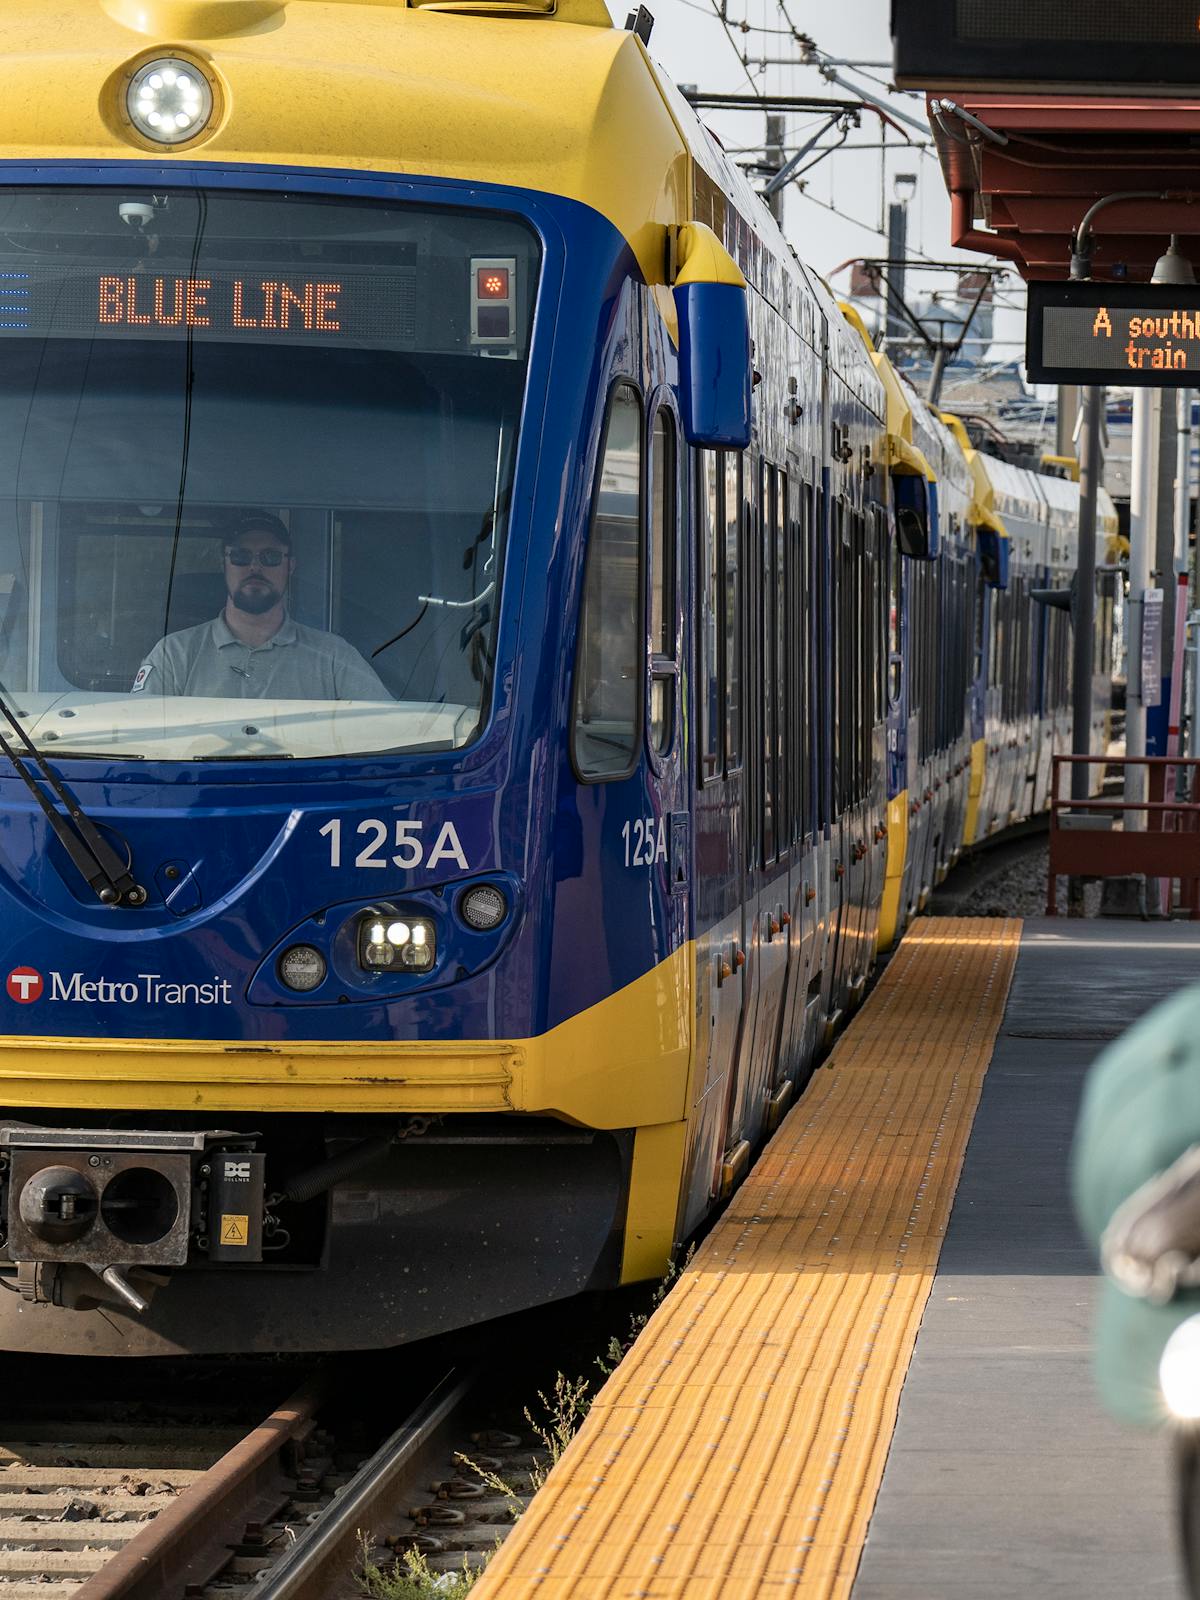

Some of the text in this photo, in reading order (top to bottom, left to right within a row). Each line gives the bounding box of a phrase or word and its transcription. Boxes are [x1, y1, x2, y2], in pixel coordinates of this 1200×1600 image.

[99, 276, 341, 331] BLUE LINE
[1092, 307, 1113, 338] A
[1124, 340, 1187, 369] train
[318, 818, 470, 870] 125A
[621, 815, 669, 868] 125A
